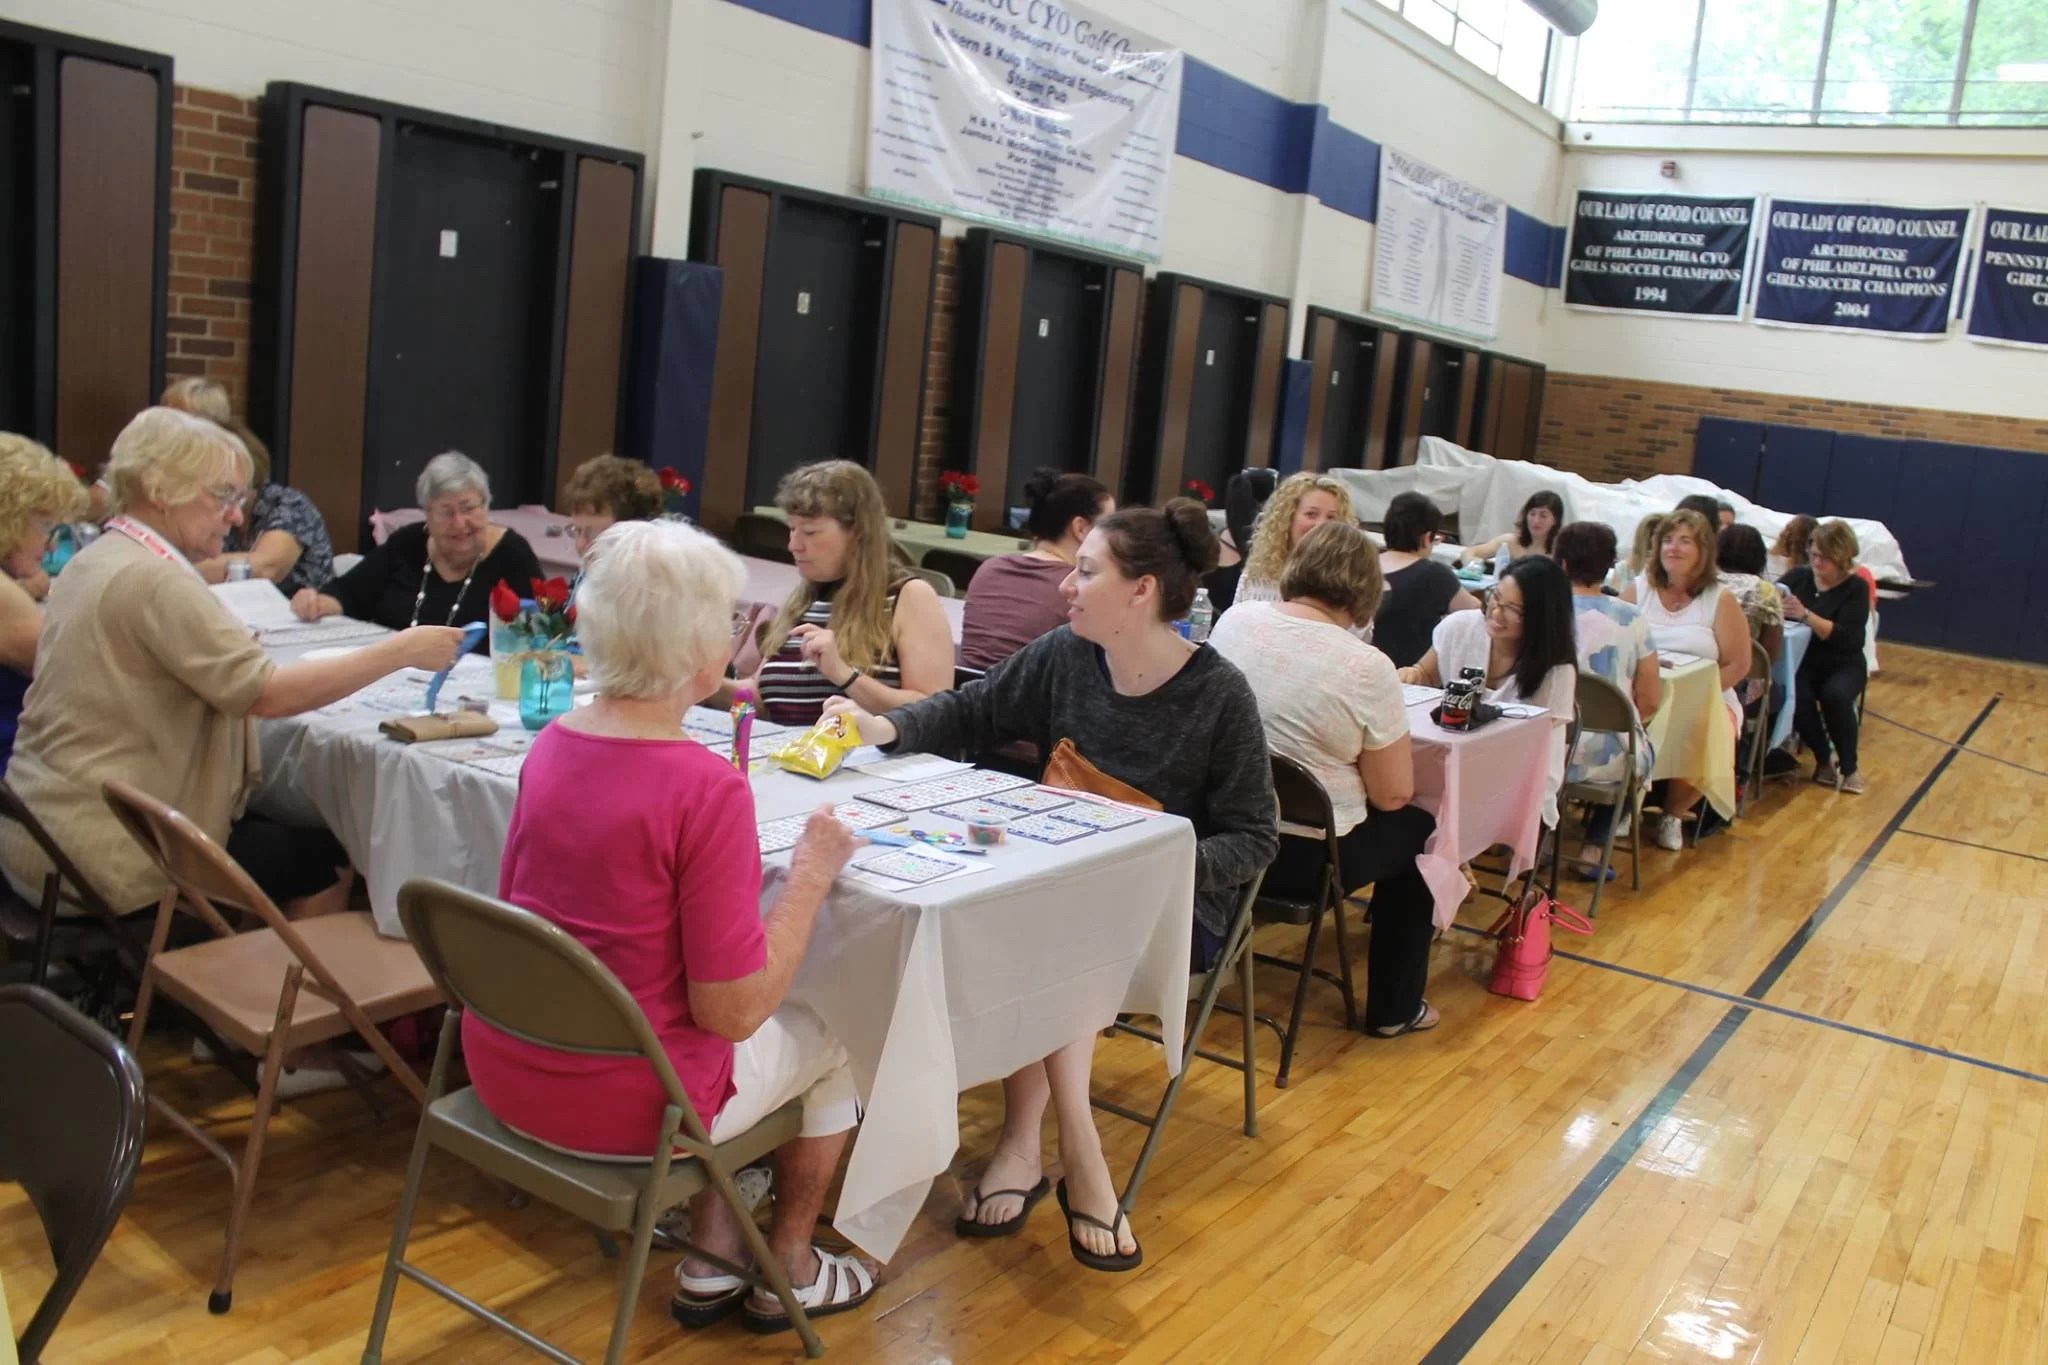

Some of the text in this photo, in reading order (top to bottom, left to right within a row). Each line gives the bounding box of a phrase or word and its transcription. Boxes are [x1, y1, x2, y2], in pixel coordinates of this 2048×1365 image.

[1074, 20, 1118, 52] Golf
[1579, 200, 1748, 225] OUR LADY OF GOOD COUNSEL
[1772, 211, 1960, 238] OUR LADY OF GOOD COUNSEL
[1990, 220, 2022, 240] OUR
[1613, 230, 1706, 246] ARCHDIOCESE
[1585, 245, 1730, 265] OF PHILADELPHIA CYO
[1810, 243, 1909, 262] ARCHDIOCESE
[1985, 250, 2048, 270] PENNSY
[1570, 259, 1742, 281] GIRLS SOCCER CHAMPIONS
[1781, 257, 1937, 279] OF PHILADELPHIA CYO
[1634, 286, 1668, 302] 1994
[1766, 272, 1948, 296] GIRLS SOCCER CHAMPIONS
[1834, 301, 1871, 318] 2004
